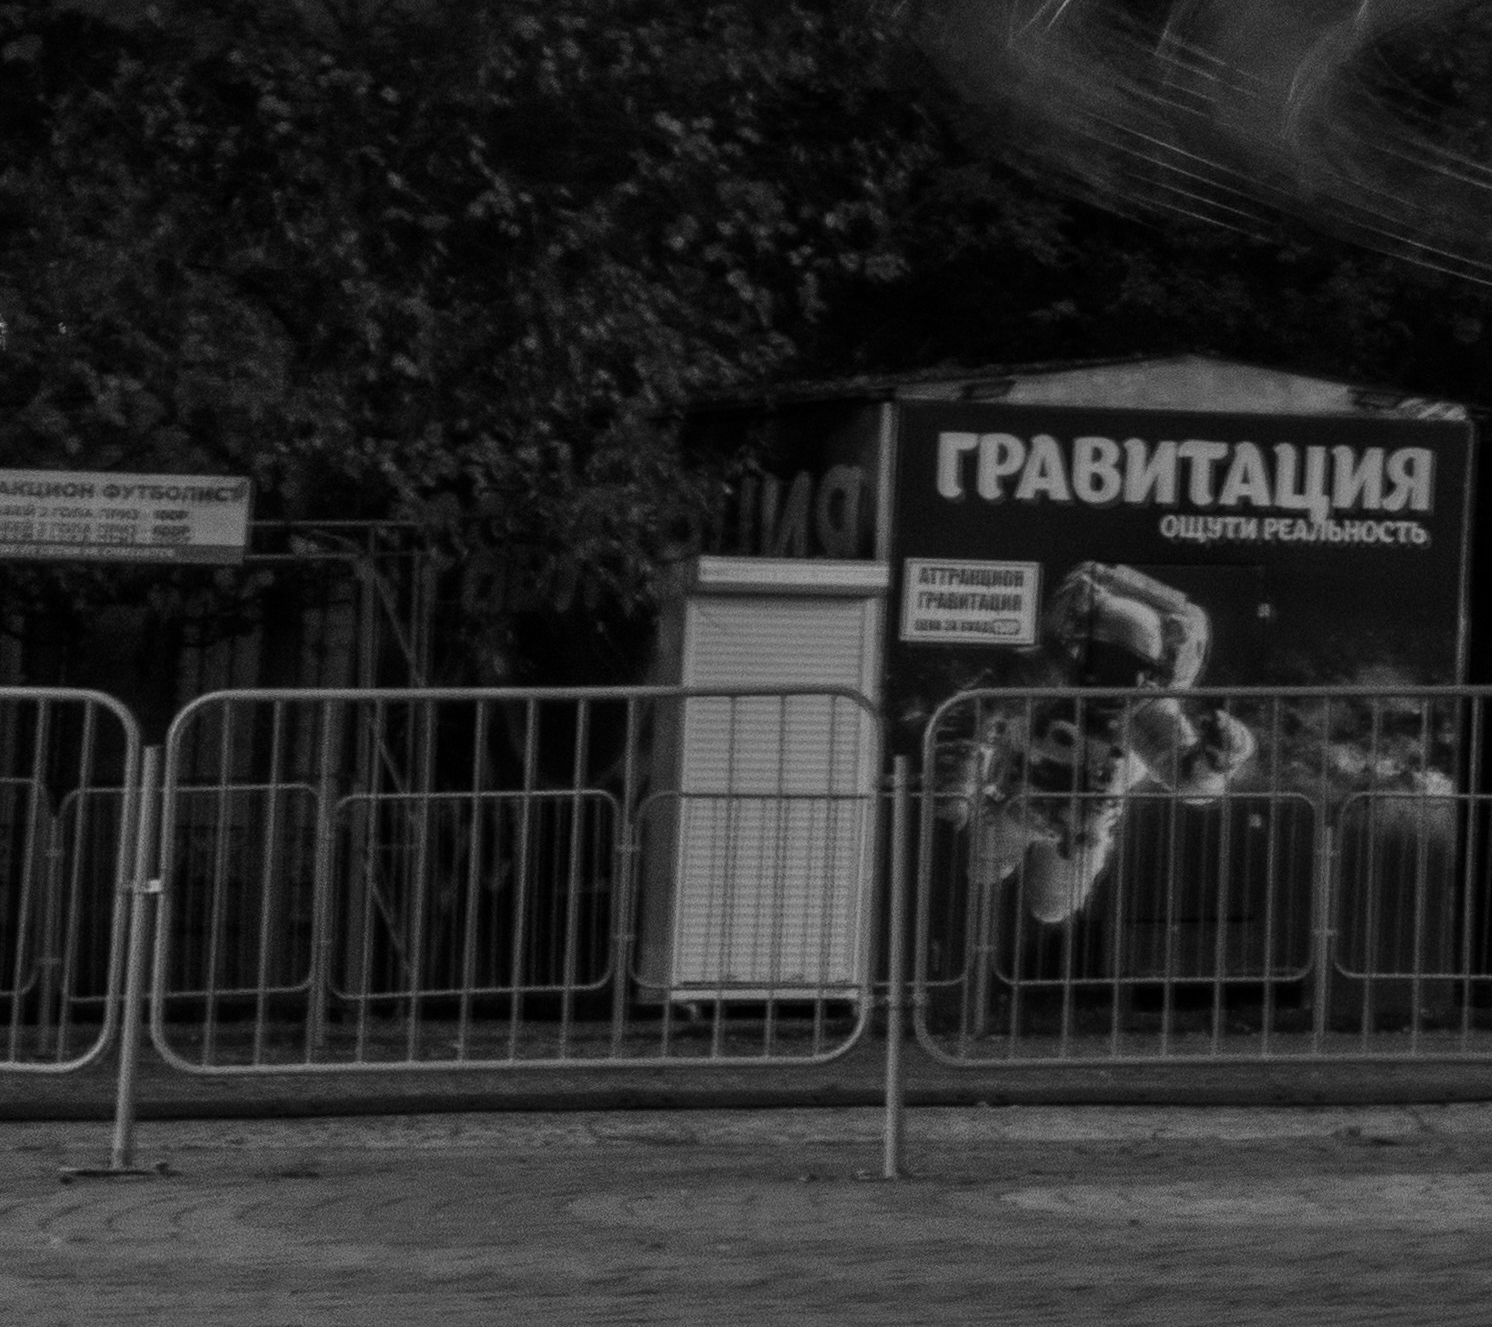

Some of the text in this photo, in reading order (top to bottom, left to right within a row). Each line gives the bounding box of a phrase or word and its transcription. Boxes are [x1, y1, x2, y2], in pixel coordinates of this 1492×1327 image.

[936, 430, 1435, 522] ГРАВИТАЦИЯ
[1159, 513, 1428, 545] ОЩУТИ РЕАЛЬНОСТЬ
[917, 591, 1022, 612] ГРАВИТАЦИЯ
